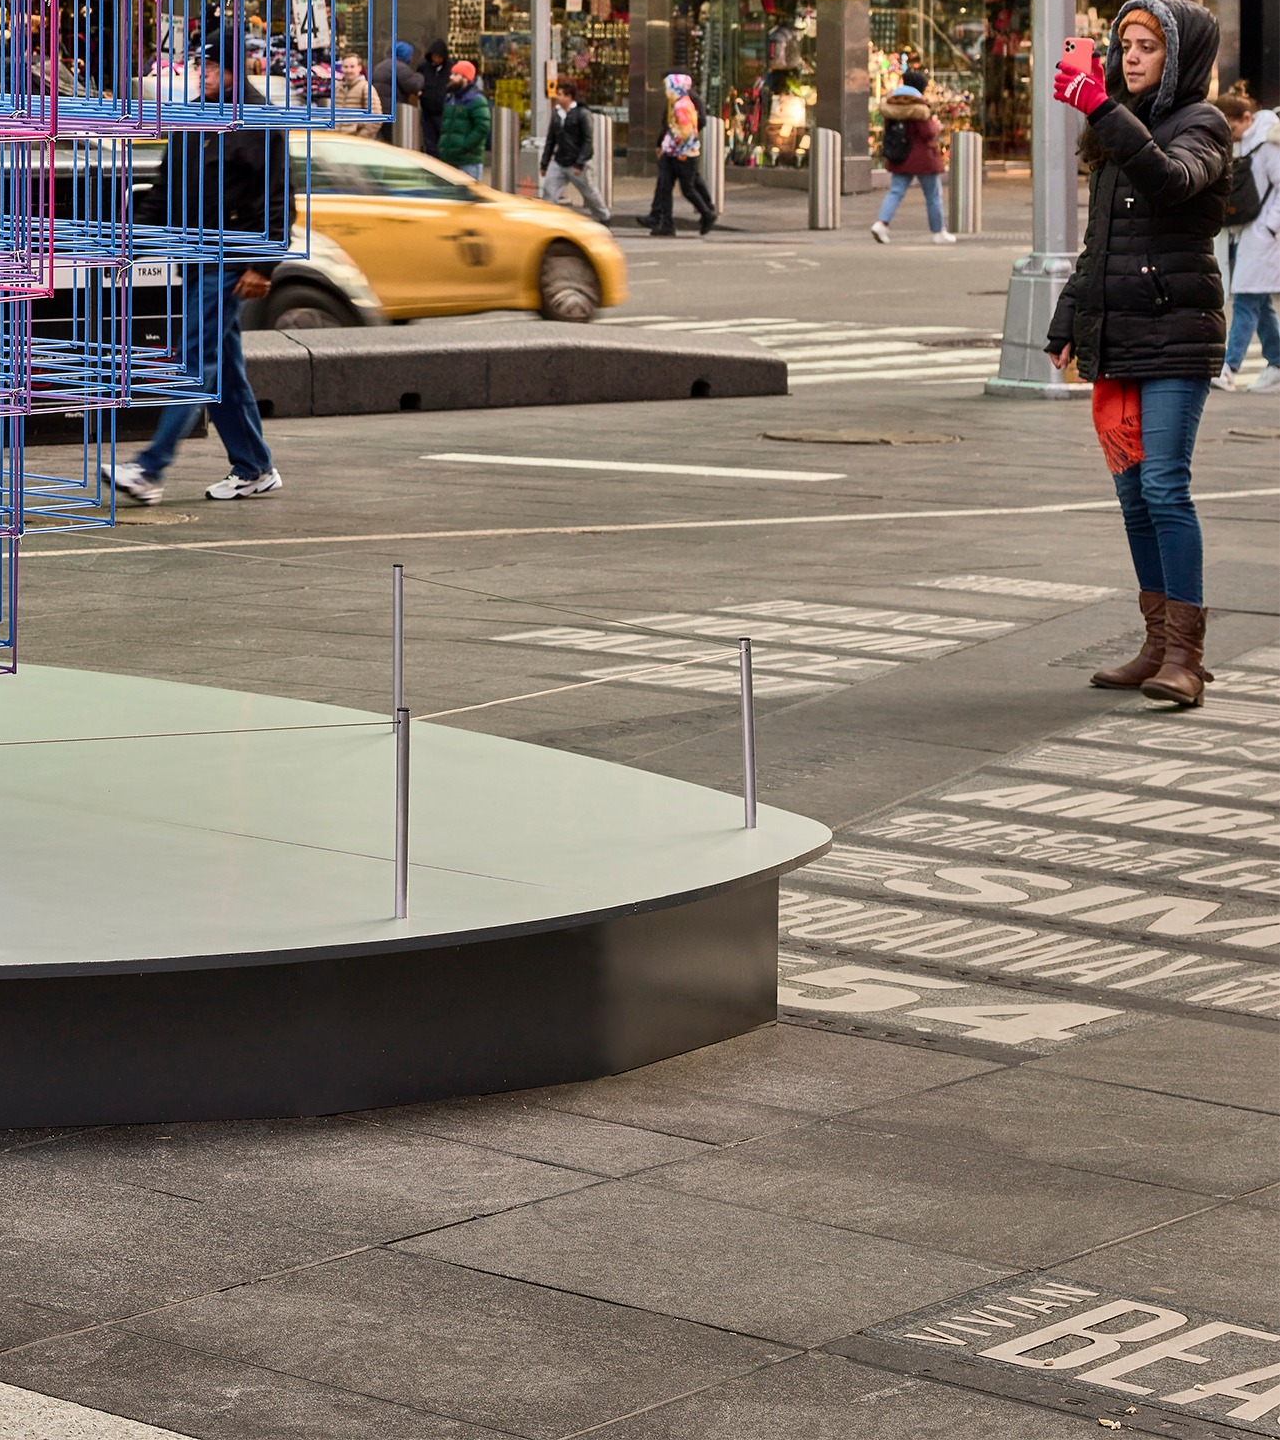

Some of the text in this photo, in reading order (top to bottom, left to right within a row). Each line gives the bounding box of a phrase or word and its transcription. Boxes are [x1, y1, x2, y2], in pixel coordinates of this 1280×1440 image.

[137, 266, 163, 277] TRASH
[888, 813, 1232, 865] CIRCLE
[993, 843, 1179, 876] SQUARE
[903, 1282, 1101, 1346] VIVIAN
